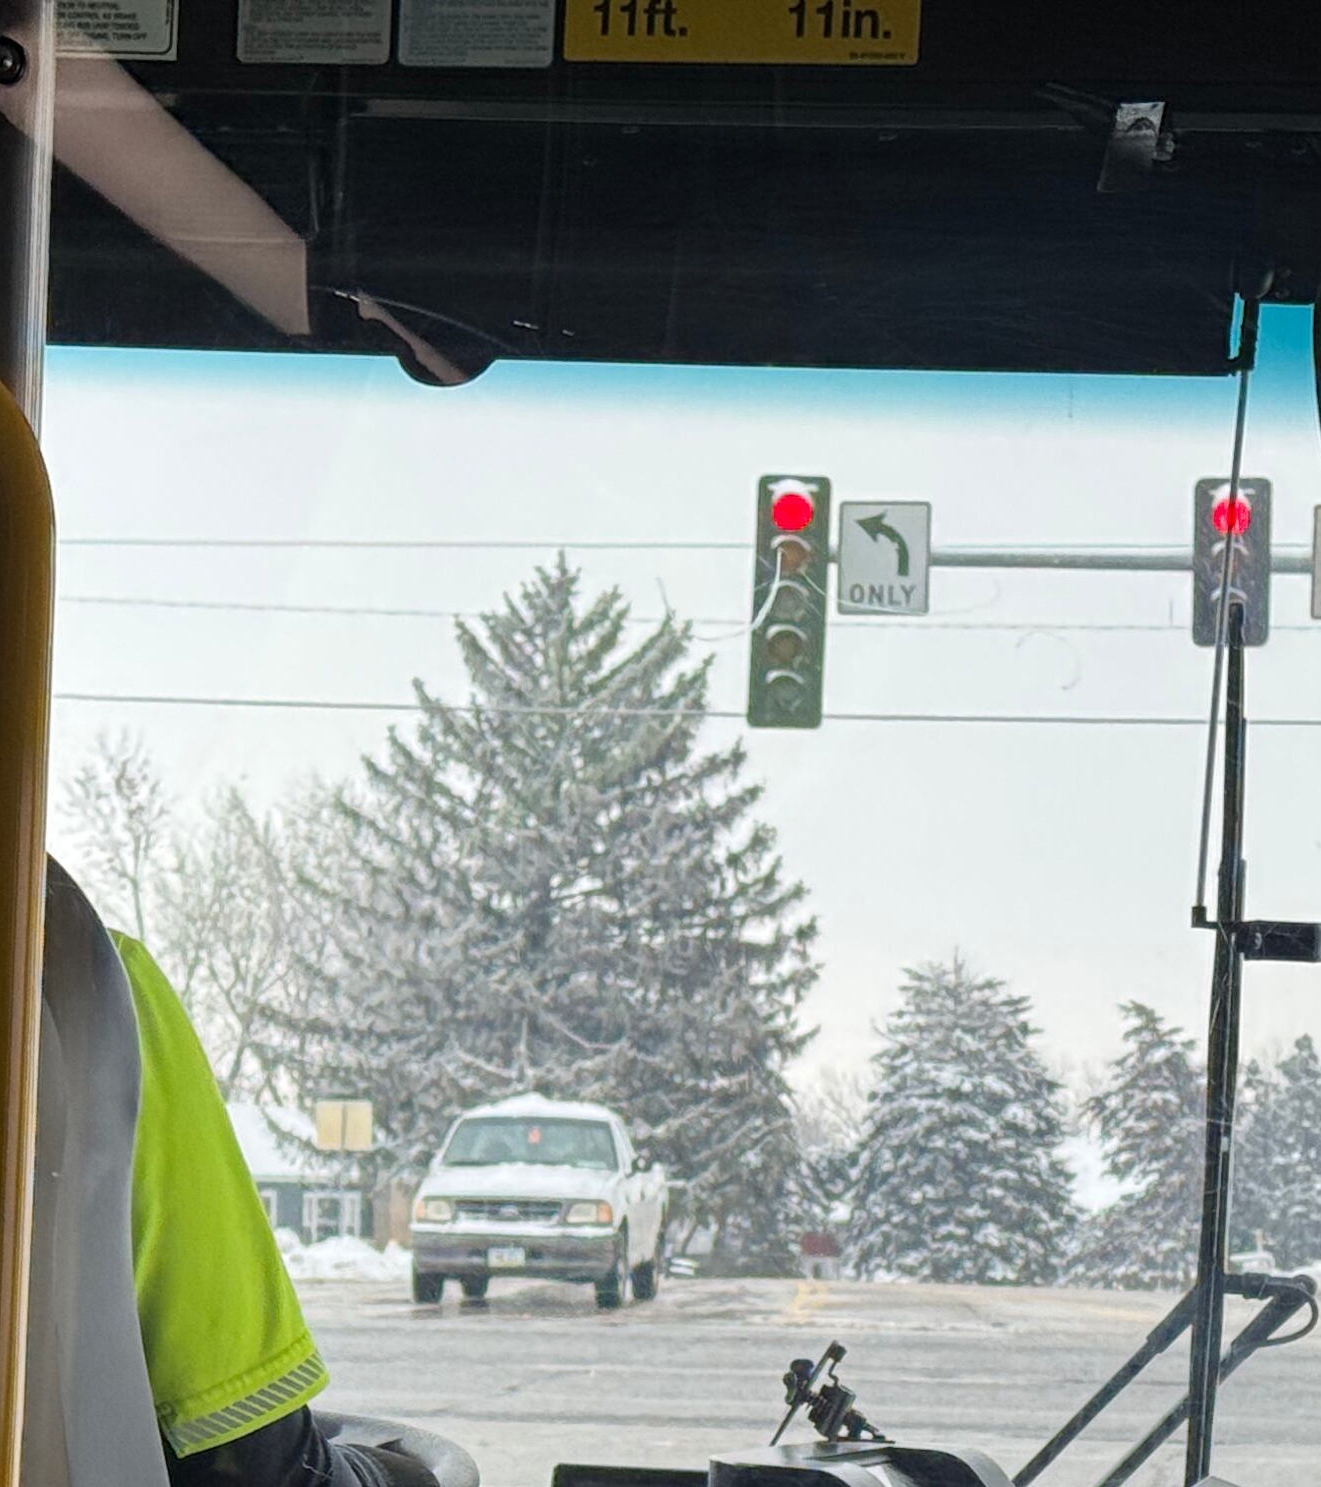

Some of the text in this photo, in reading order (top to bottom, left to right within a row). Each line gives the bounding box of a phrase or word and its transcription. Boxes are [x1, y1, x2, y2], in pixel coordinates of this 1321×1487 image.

[594, 0, 688, 37] 11ft.
[788, 0, 892, 39] 11in.
[849, 583, 917, 606] ONLY
